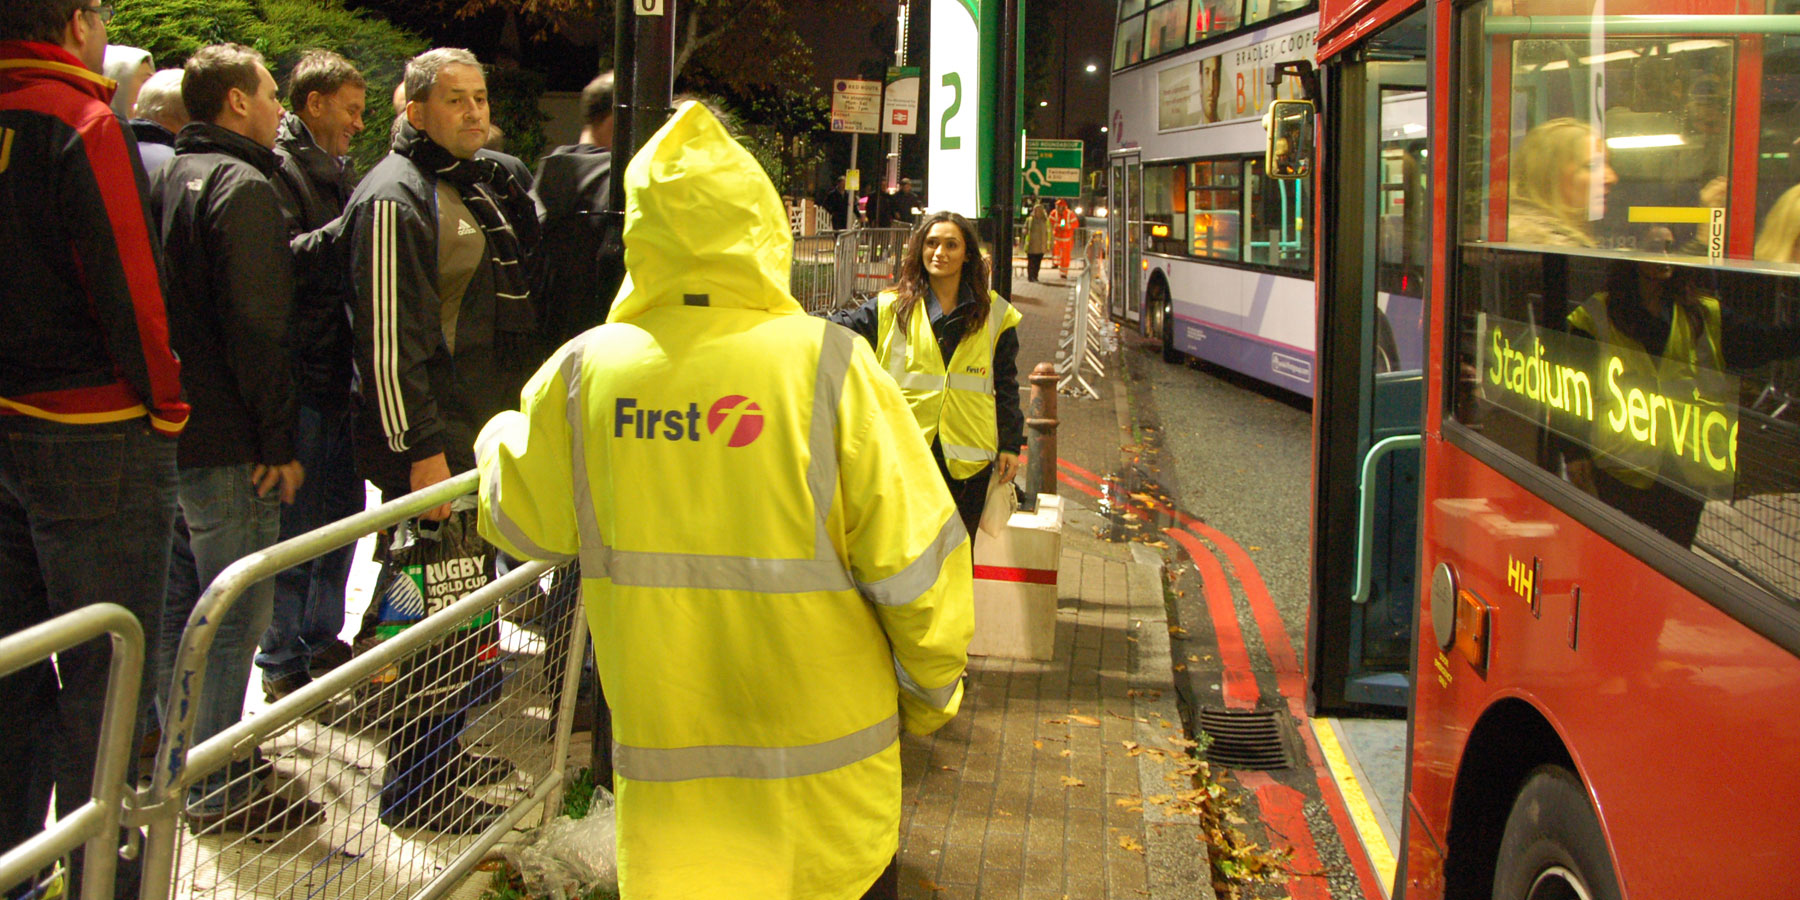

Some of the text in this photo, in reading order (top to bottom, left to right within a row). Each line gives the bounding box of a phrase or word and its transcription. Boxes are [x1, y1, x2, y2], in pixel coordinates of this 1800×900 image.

[1236, 43, 1275, 66] BRADLEY
[940, 71, 962, 150] 2
[1711, 209, 1722, 259] PUSH
[1489, 325, 1593, 421] Stadium
[614, 397, 701, 442] First
[426, 554, 485, 584] RUGBY
[427, 575, 488, 596] WORLD CUP
[1508, 553, 1534, 605] HH
